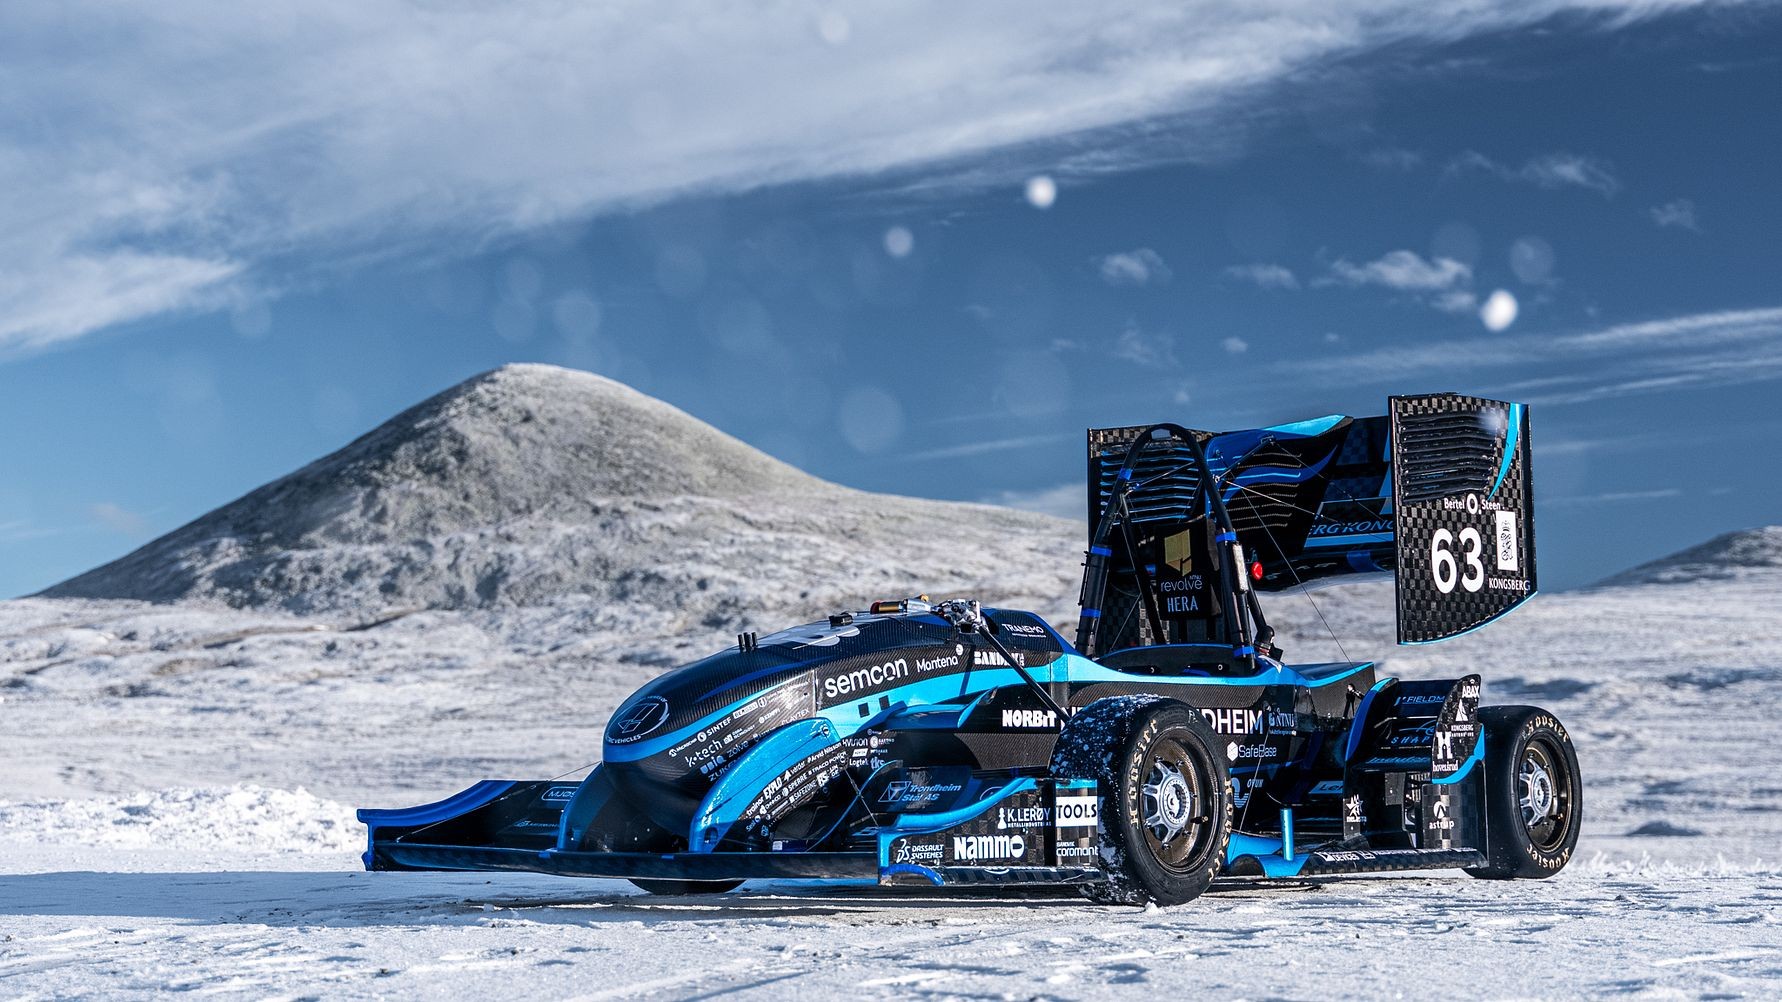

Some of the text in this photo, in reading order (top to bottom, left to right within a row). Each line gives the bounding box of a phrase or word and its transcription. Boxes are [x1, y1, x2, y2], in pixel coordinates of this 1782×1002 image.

[1444, 498, 1465, 509] Bertel
[1481, 499, 1501, 510] Steen
[1431, 527, 1485, 594] 63
[1160, 578, 1203, 593] revolve
[1488, 577, 1531, 591] KONGSBERG
[1167, 596, 1199, 613] HERA
[824, 658, 909, 698] semcon
[1461, 685, 1480, 698] ABAX
[706, 717, 732, 736] SINTEF
[1201, 708, 1264, 735] DHEIM
[1238, 743, 1277, 759] SafeBase
[910, 783, 962, 793] Trondheim
[924, 793, 940, 802] AS
[1056, 803, 1097, 819] TOOLS
[1428, 820, 1455, 830] astrup
[911, 844, 944, 852] DASSAULT
[1056, 845, 1099, 857] coromant
